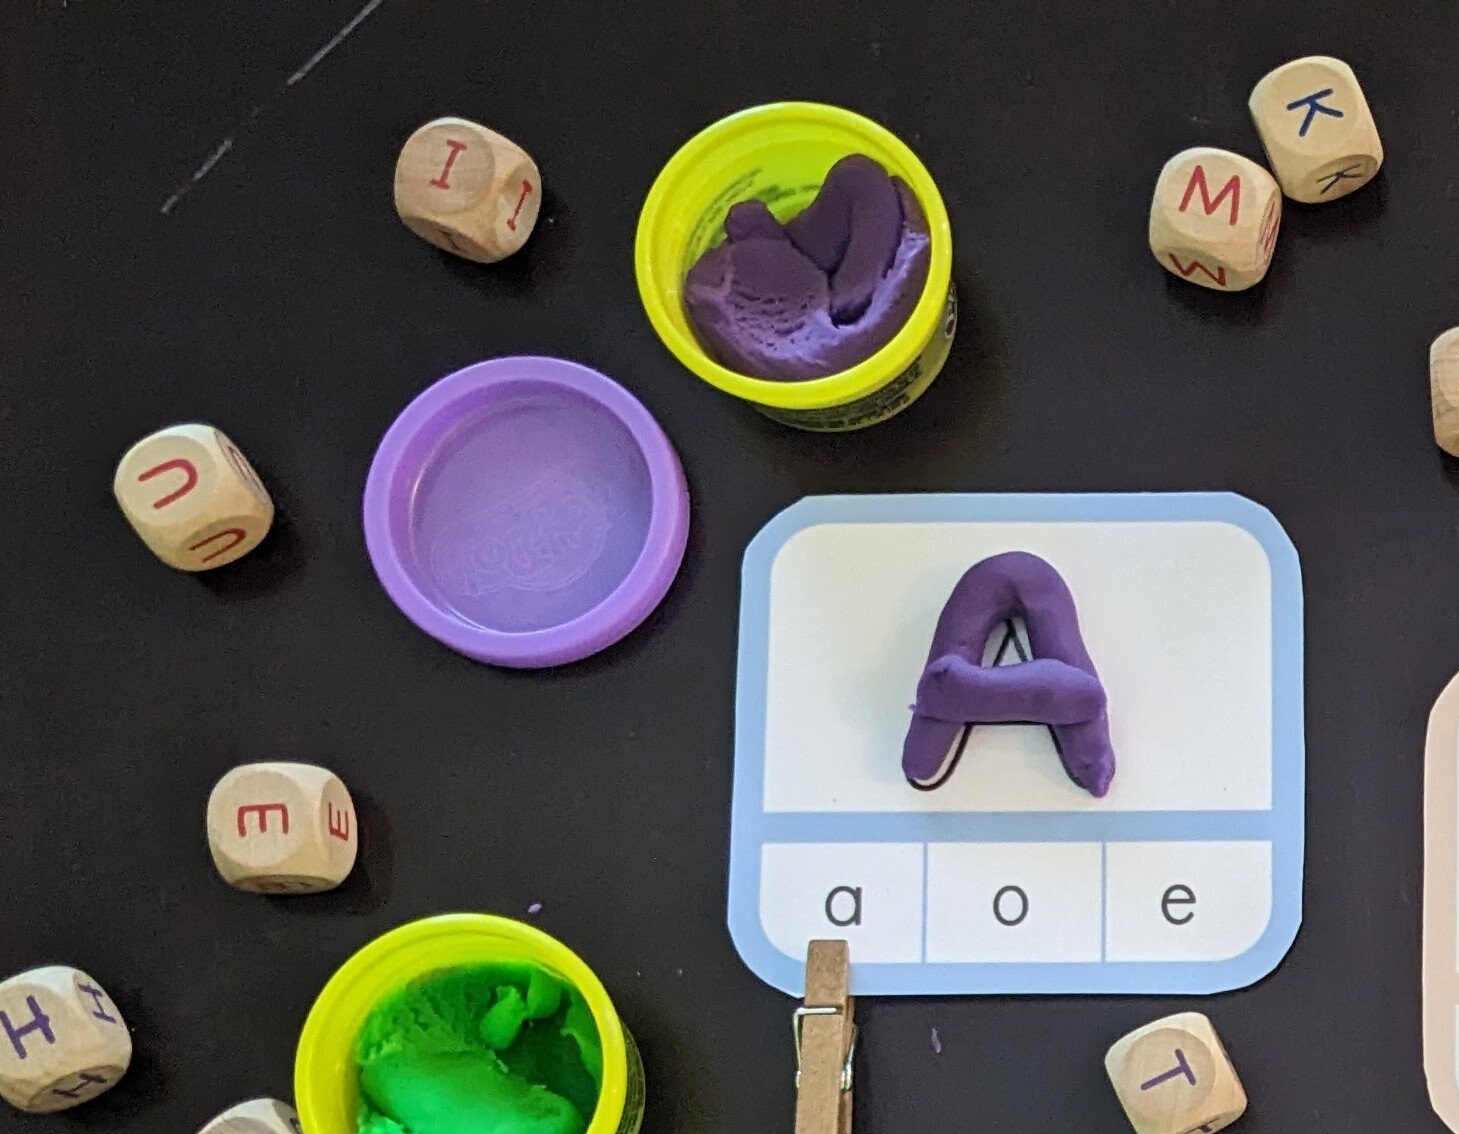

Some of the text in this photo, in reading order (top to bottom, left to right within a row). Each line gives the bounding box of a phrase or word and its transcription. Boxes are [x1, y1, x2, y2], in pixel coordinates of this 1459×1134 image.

[1287, 88, 1344, 136] K
[428, 140, 468, 190] I
[1178, 165, 1241, 226] M
[138, 459, 198, 509] U
[901, 551, 1116, 798] A
[237, 803, 289, 838] E
[328, 802, 349, 841] E
[824, 884, 863, 926] a
[993, 885, 1029, 926] o
[1160, 883, 1197, 925] e
[0, 995, 55, 1059] H
[1141, 1048, 1196, 1090] T
